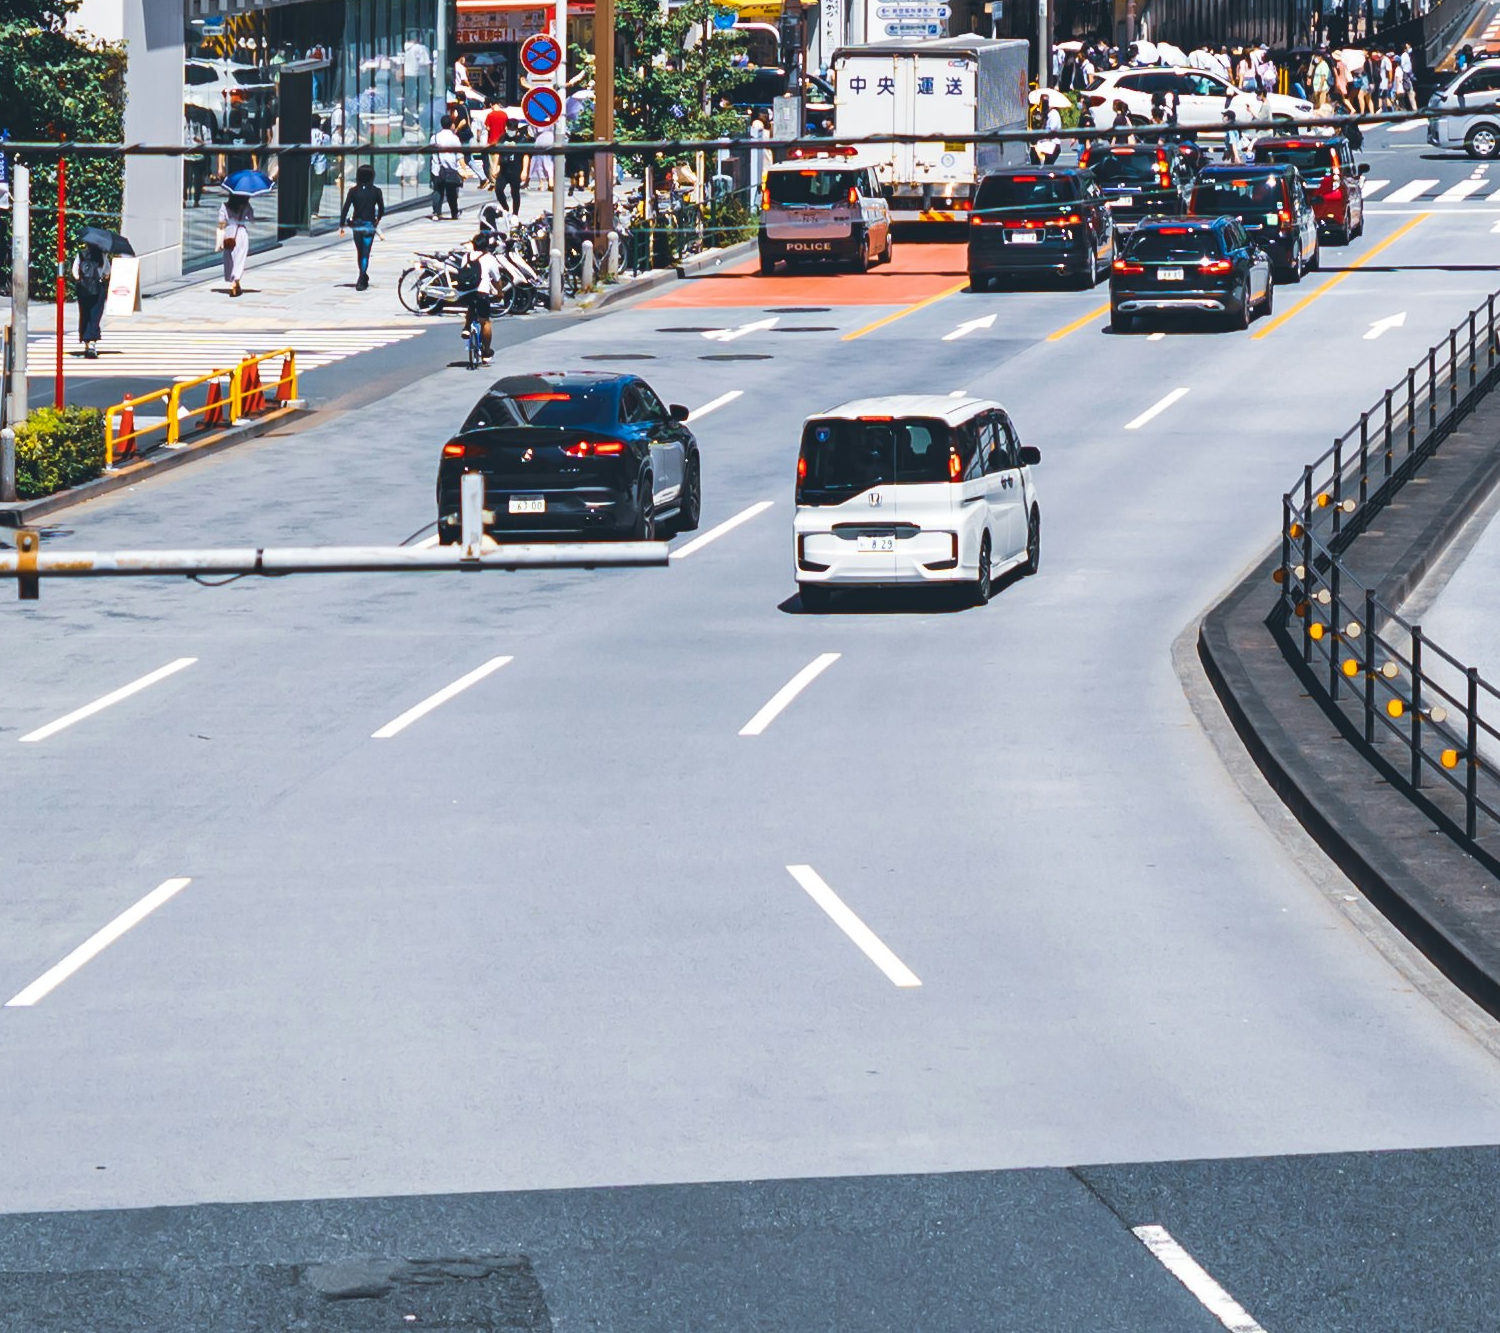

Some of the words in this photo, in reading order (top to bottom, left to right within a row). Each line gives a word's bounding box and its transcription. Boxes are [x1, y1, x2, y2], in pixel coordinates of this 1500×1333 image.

[849, 75, 963, 97] 中央運送
[786, 243, 832, 251] POLICE
